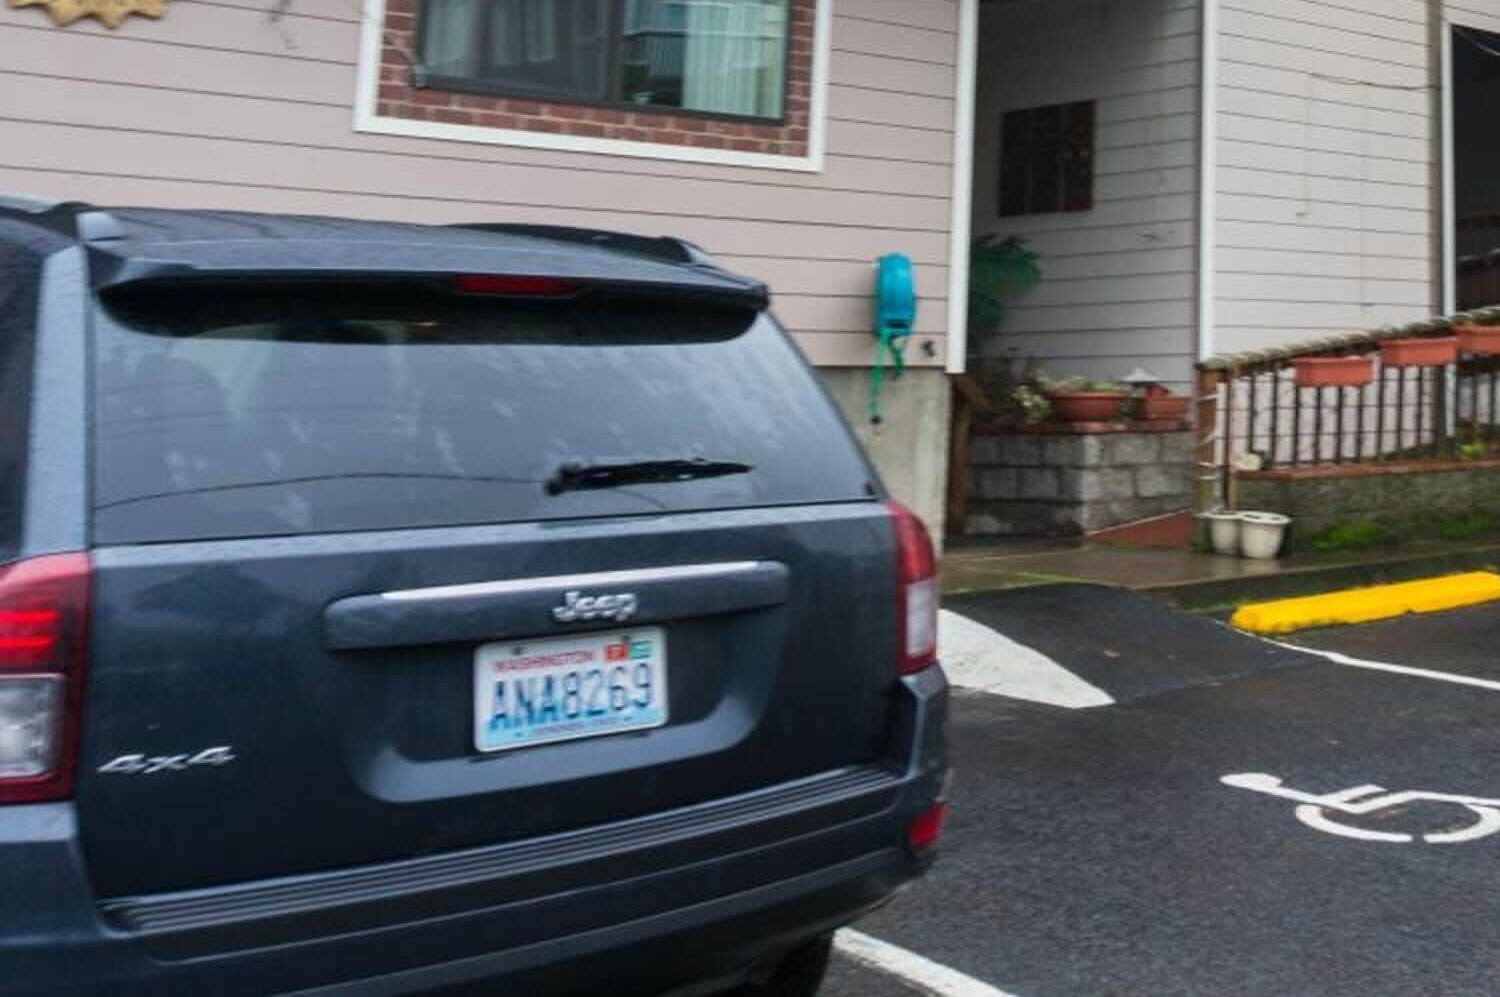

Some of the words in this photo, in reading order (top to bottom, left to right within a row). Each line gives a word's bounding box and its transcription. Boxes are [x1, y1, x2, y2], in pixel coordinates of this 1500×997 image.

[552, 591, 638, 622] Jeep
[490, 662, 653, 731] ANA8269
[97, 746, 237, 774] 4x4
